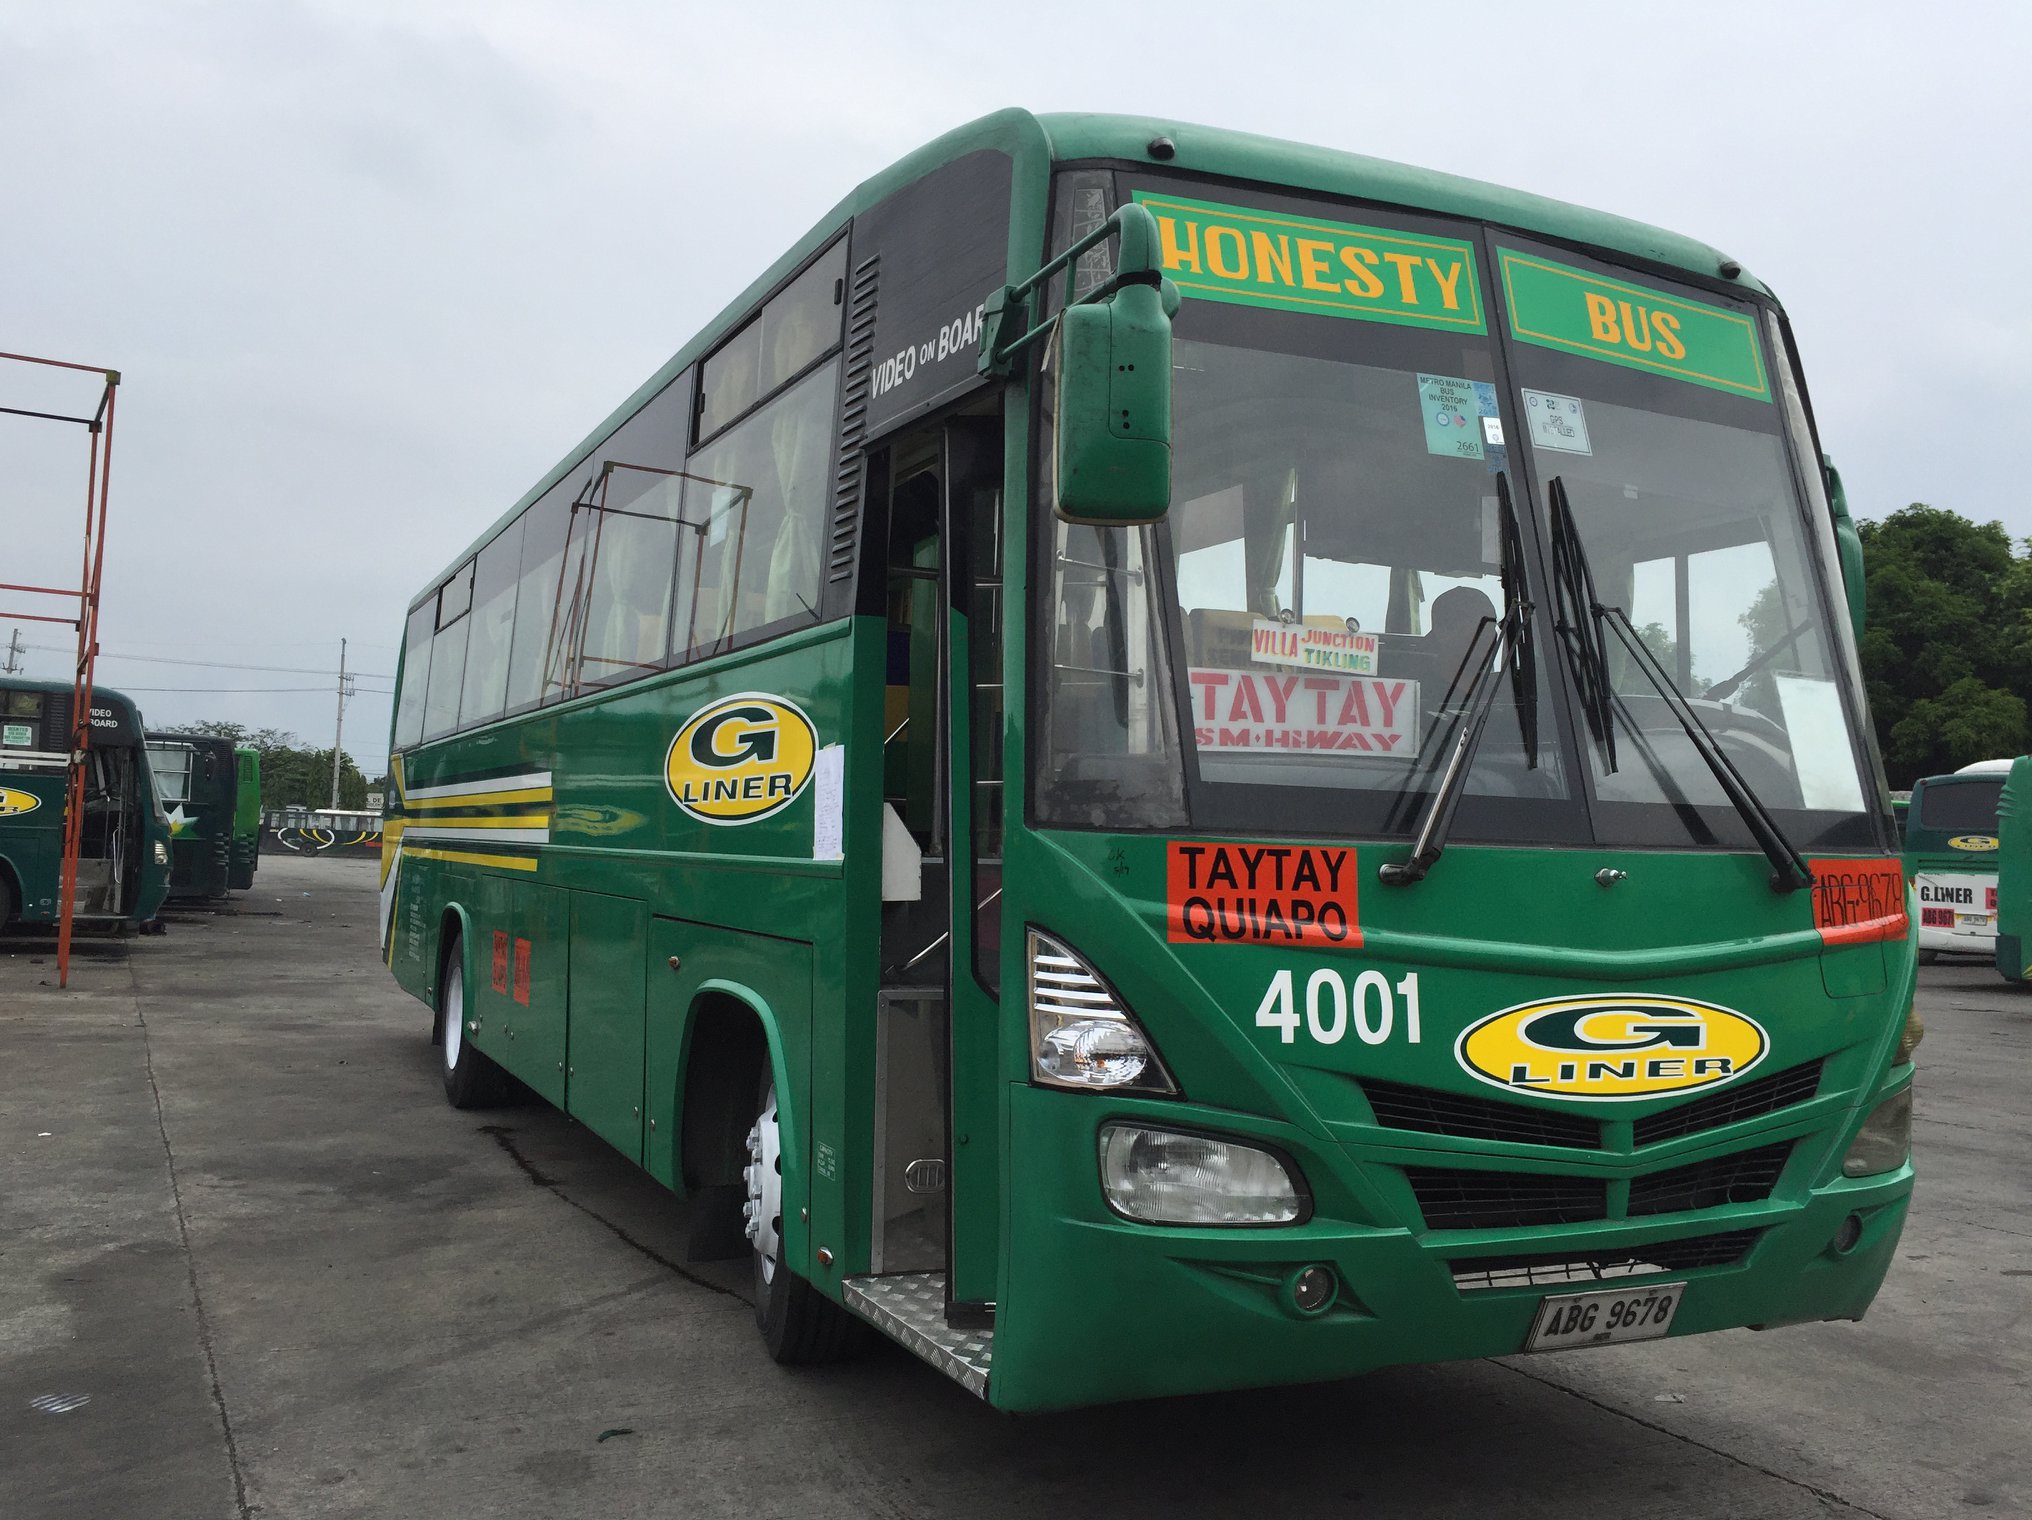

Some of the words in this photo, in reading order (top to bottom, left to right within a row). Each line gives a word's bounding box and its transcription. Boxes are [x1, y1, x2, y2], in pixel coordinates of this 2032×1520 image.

[1158, 217, 1462, 310] HONESTY
[1586, 292, 1686, 360] BUS
[872, 345, 916, 399] VIDEO
[920, 339, 936, 365] ON
[937, 303, 985, 362] BOAR
[1420, 377, 1445, 387] METRO
[1445, 381, 1472, 390] MANILA
[1428, 394, 1468, 405] INVENTORY
[1440, 387, 1455, 396] BUS
[1549, 414, 1564, 425] GPS
[1456, 440, 1479, 452] 2661
[1253, 628, 1298, 658] VILLA
[1302, 629, 1375, 654] JUNCTION
[1304, 647, 1371, 673] TIKLING
[1191, 672, 1407, 728] TAYTAY
[690, 706, 780, 770] G
[682, 773, 793, 804] LINER
[1179, 847, 1347, 893] TAYTAY
[1920, 886, 1973, 904] G.LINER
[1182, 897, 1347, 943] QUIAPO
[1255, 969, 1421, 1044] 4001
[1516, 1003, 1705, 1053] G
[1508, 1057, 1734, 1086] LINER
[1543, 1302, 1600, 1337] ABG
[1606, 1296, 1673, 1330] 9678
